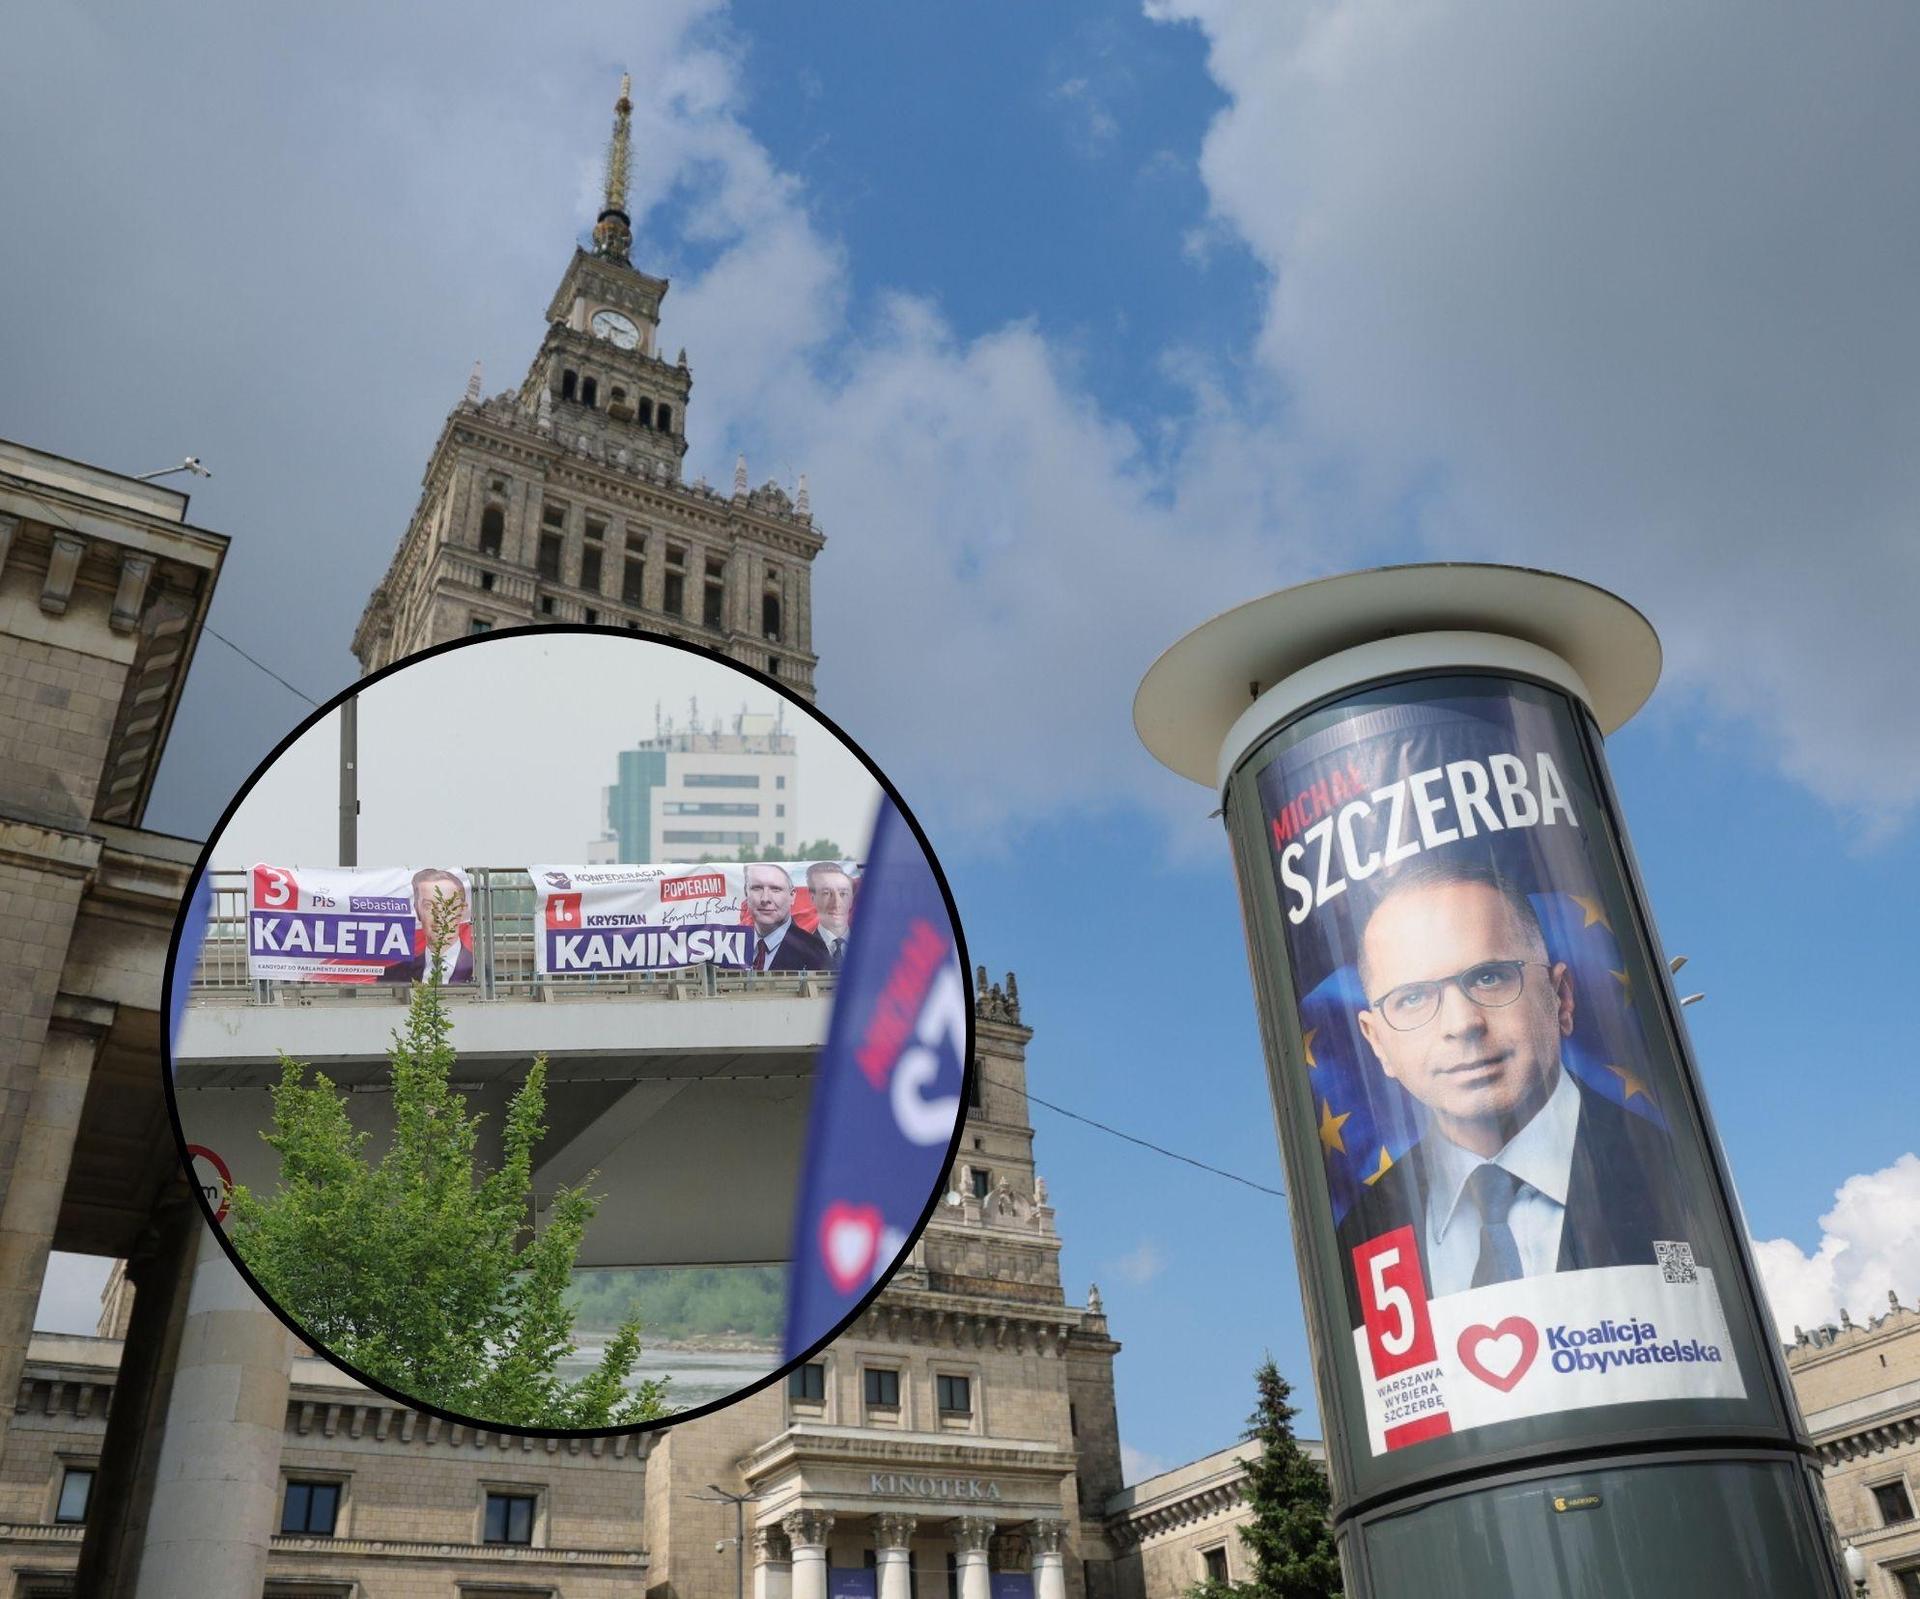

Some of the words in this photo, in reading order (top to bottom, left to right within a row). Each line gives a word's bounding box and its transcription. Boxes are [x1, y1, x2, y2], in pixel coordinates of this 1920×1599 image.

[1271, 761, 1370, 849] MICHAŁ
[1280, 752, 1579, 925] SZCZERBA
[264, 870, 290, 906] 3
[574, 870, 666, 881] KONFEDERACJA
[663, 878, 722, 899] POPIERAM!
[352, 898, 409, 912] Sebastian
[553, 899, 573, 922] 1.
[586, 914, 647, 926] KRYSTIAN
[253, 917, 411, 956] KALETA
[555, 925, 746, 970] KAMIŃSKI
[1369, 1247, 1416, 1356] 5
[1546, 1317, 1658, 1350] Koalicja
[1551, 1339, 1723, 1374] Obywatelska
[1376, 1367, 1444, 1398] WARSZAWA
[1385, 1383, 1439, 1408] WYBIERA
[1384, 1395, 1445, 1423] SZCZERBĘ
[870, 1474, 1001, 1498] KINOTEKA
